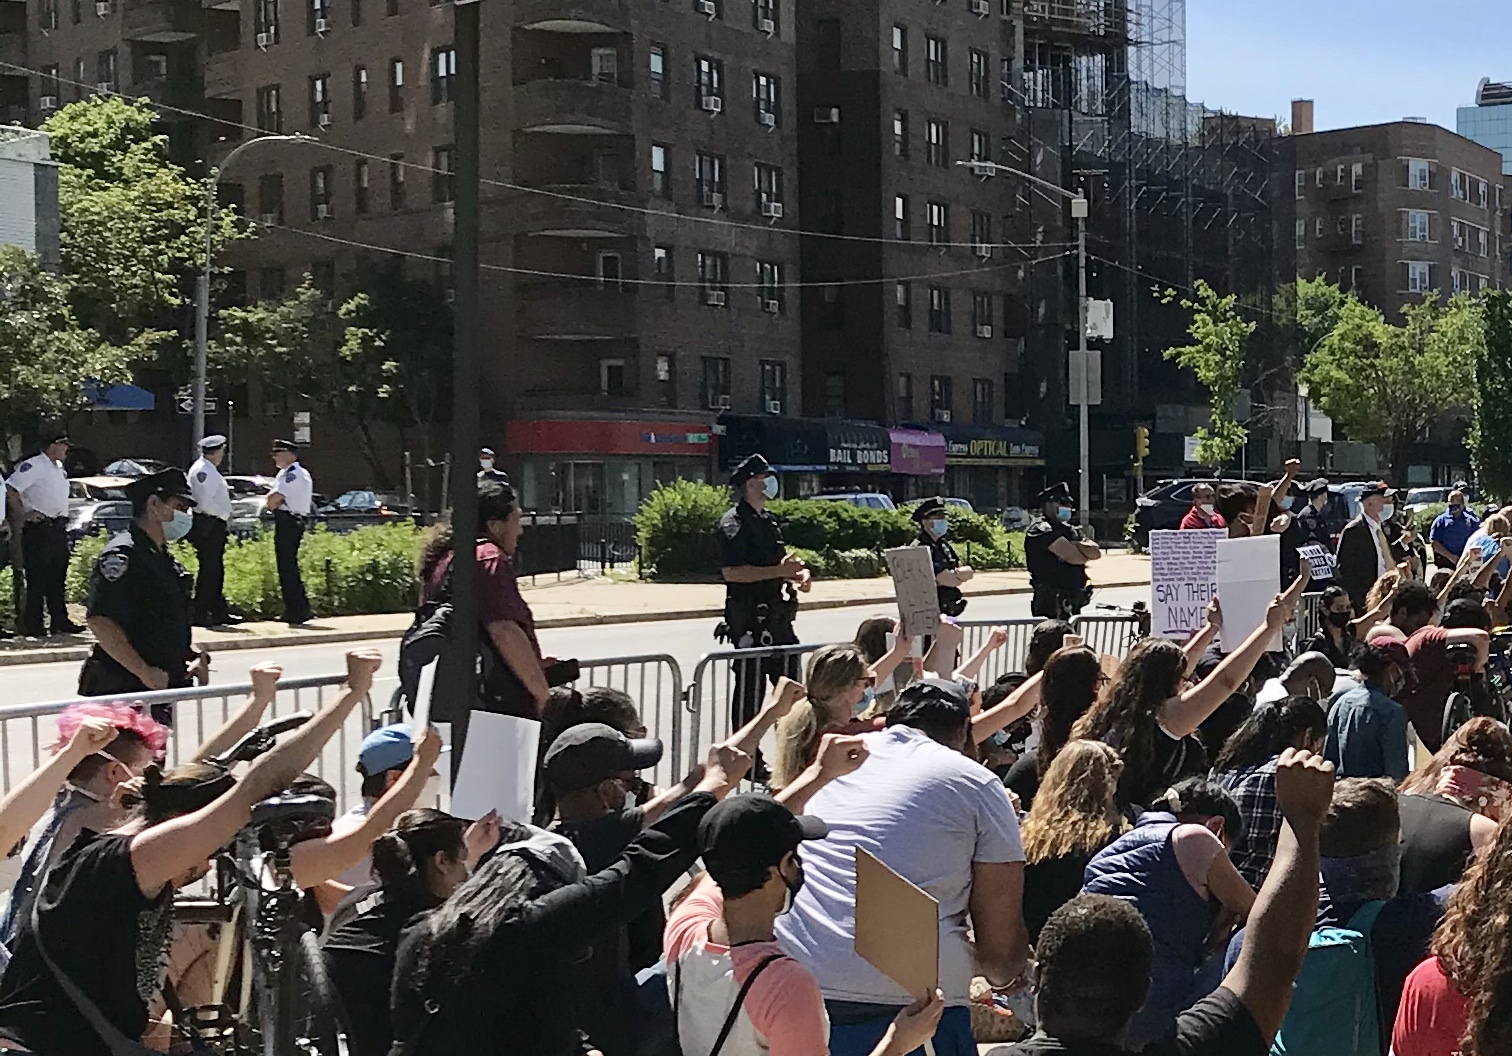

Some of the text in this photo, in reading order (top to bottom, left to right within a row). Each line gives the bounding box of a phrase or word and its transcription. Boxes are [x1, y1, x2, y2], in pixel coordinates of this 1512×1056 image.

[829, 448, 852, 464] BAIL
[856, 449, 889, 464] BONDS
[970, 440, 1009, 456] OPTICAL
[1156, 584, 1180, 604] SAY
